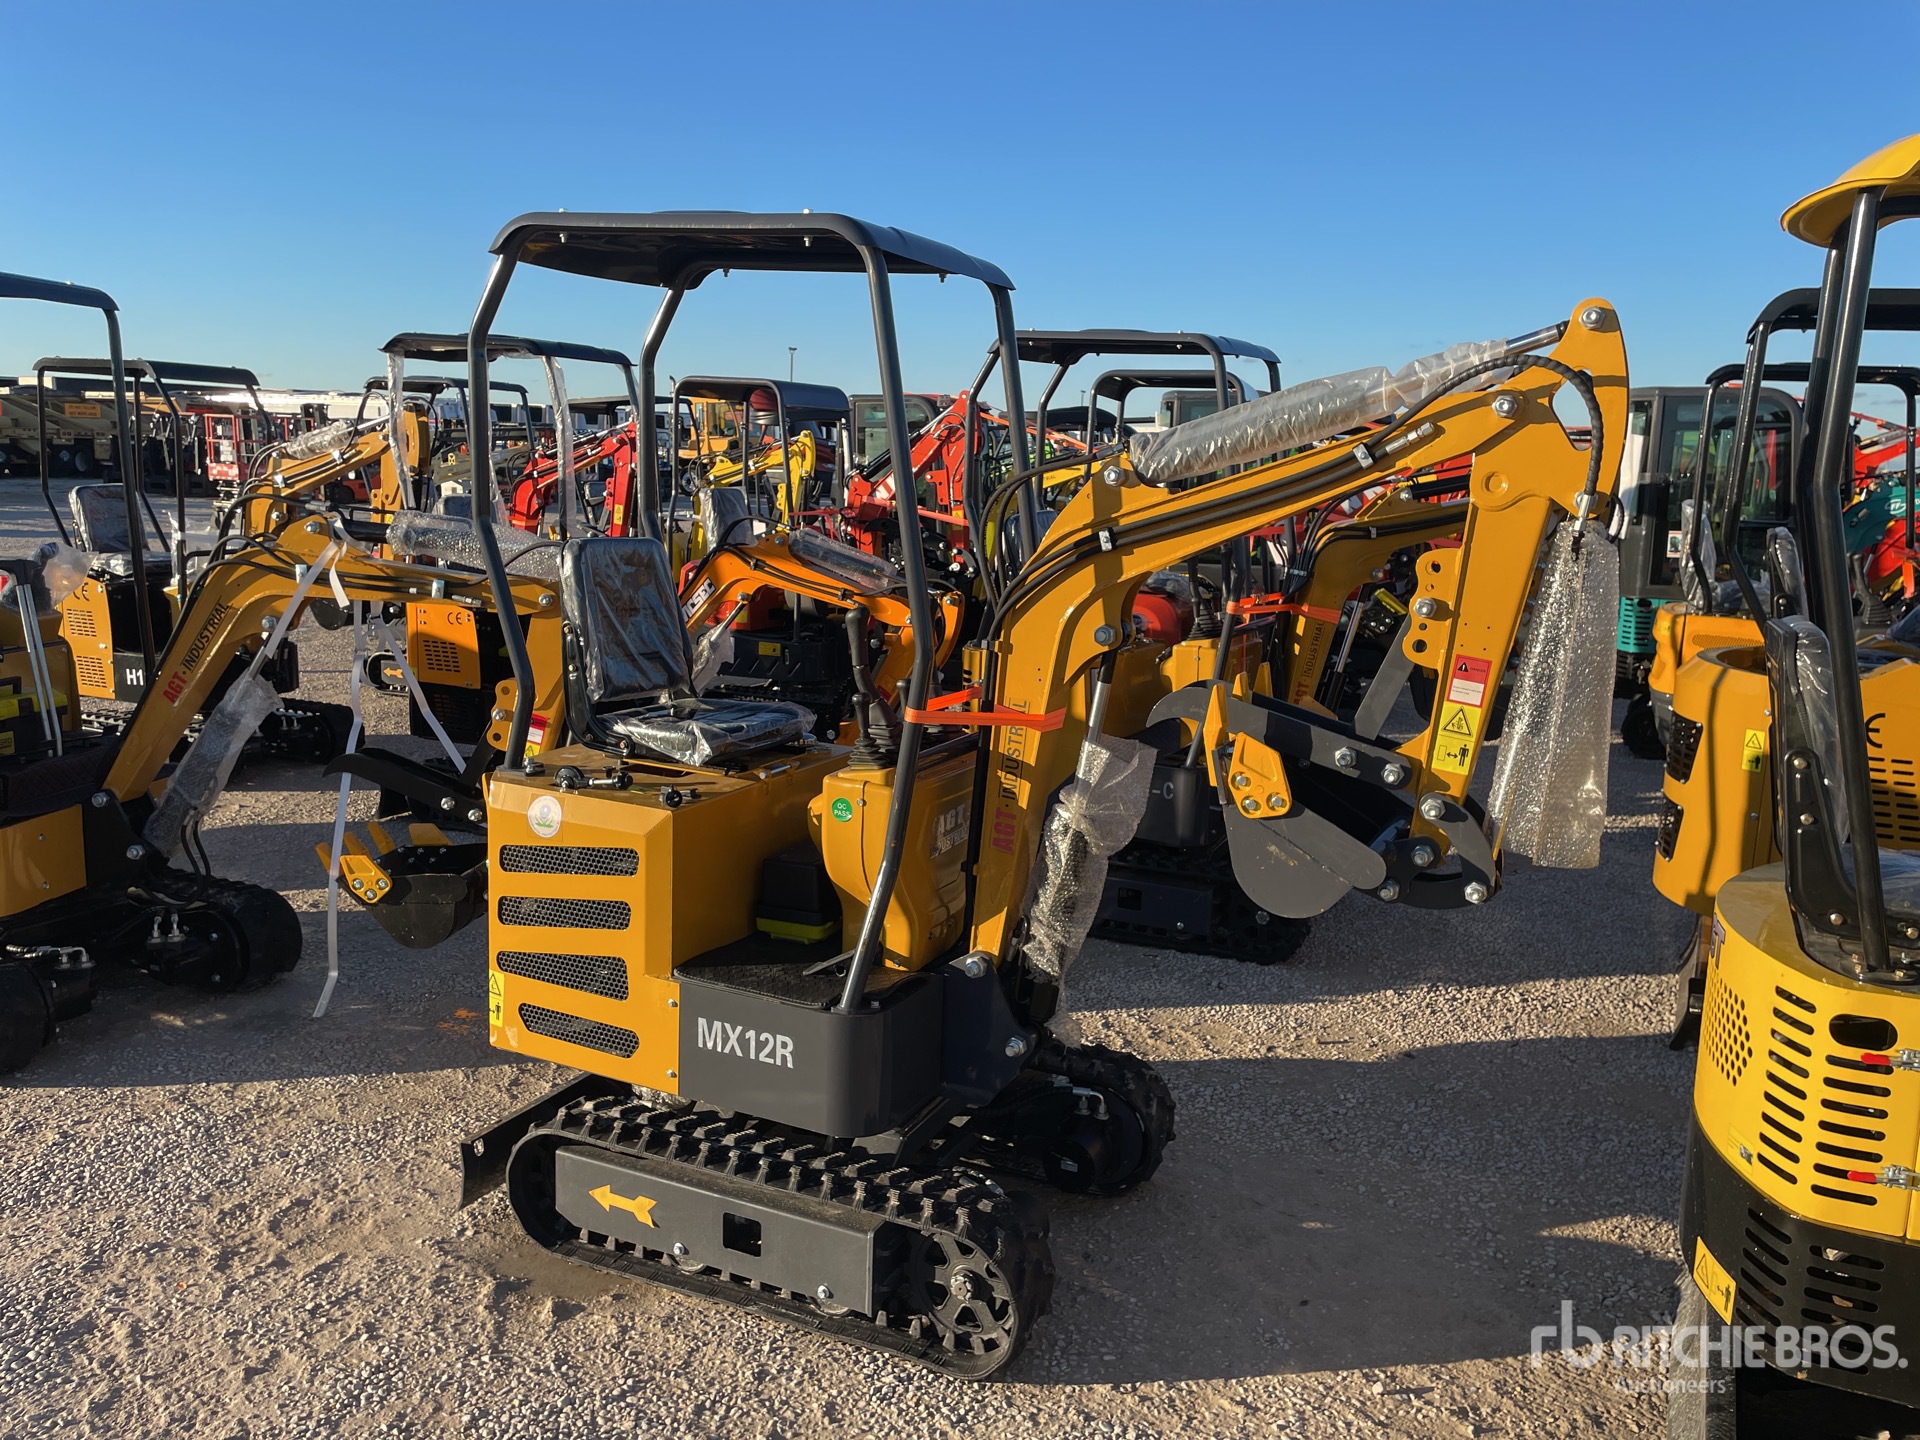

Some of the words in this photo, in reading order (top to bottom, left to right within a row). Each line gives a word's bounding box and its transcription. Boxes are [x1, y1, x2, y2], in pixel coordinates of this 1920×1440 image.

[162, 671, 189, 705] AGT
[183, 602, 229, 672] INDUSTRIAL
[1303, 621, 1325, 678] INDUSTRIAL
[1001, 700, 1028, 801] INDUSTRL
[834, 809, 851, 817] PASS
[934, 802, 966, 838] AGT
[992, 807, 1017, 854] AGT
[697, 1016, 794, 1069] MX12R
